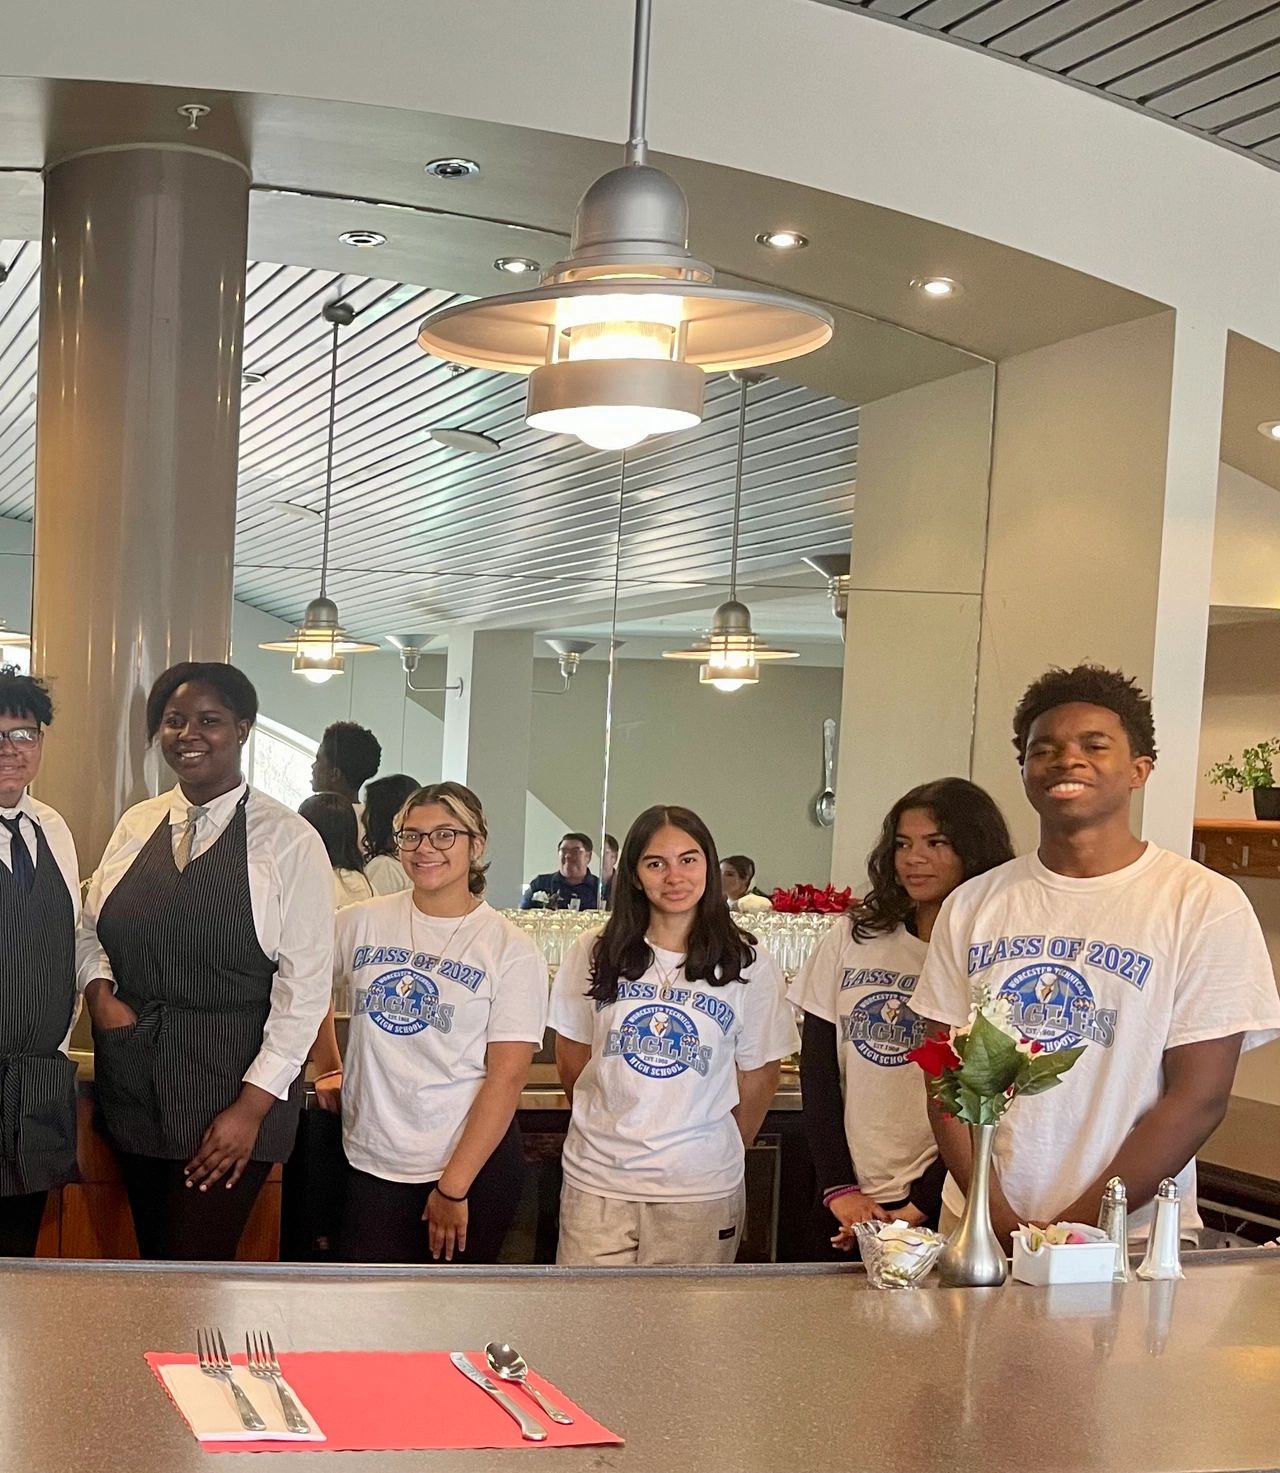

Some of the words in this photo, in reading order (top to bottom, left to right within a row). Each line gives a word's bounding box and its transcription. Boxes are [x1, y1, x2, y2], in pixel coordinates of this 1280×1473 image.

[353, 945, 413, 971] CLASS
[411, 952, 441, 972] OF
[437, 959, 486, 993] 2027
[840, 967, 900, 993] LASS
[898, 974, 920, 992] O
[968, 935, 1045, 977] CLASS
[1047, 936, 1085, 961] OF
[1085, 940, 1154, 992] 2027
[1054, 967, 1087, 995] TECHNICAL
[352, 988, 455, 1035] EAGLES
[374, 1014, 394, 1031] HIGH
[394, 1021, 424, 1034] SCHOOL
[660, 987, 691, 1006] OF
[692, 992, 735, 1036] 2027
[1007, 1000, 1118, 1048] AGLES
[602, 1030, 713, 1078] EAGLES
[629, 1056, 651, 1073] HIGH
[650, 1063, 683, 1077] SCHOOL
[858, 1043, 879, 1062] HIGH
[879, 1054, 906, 1065] SCHO
